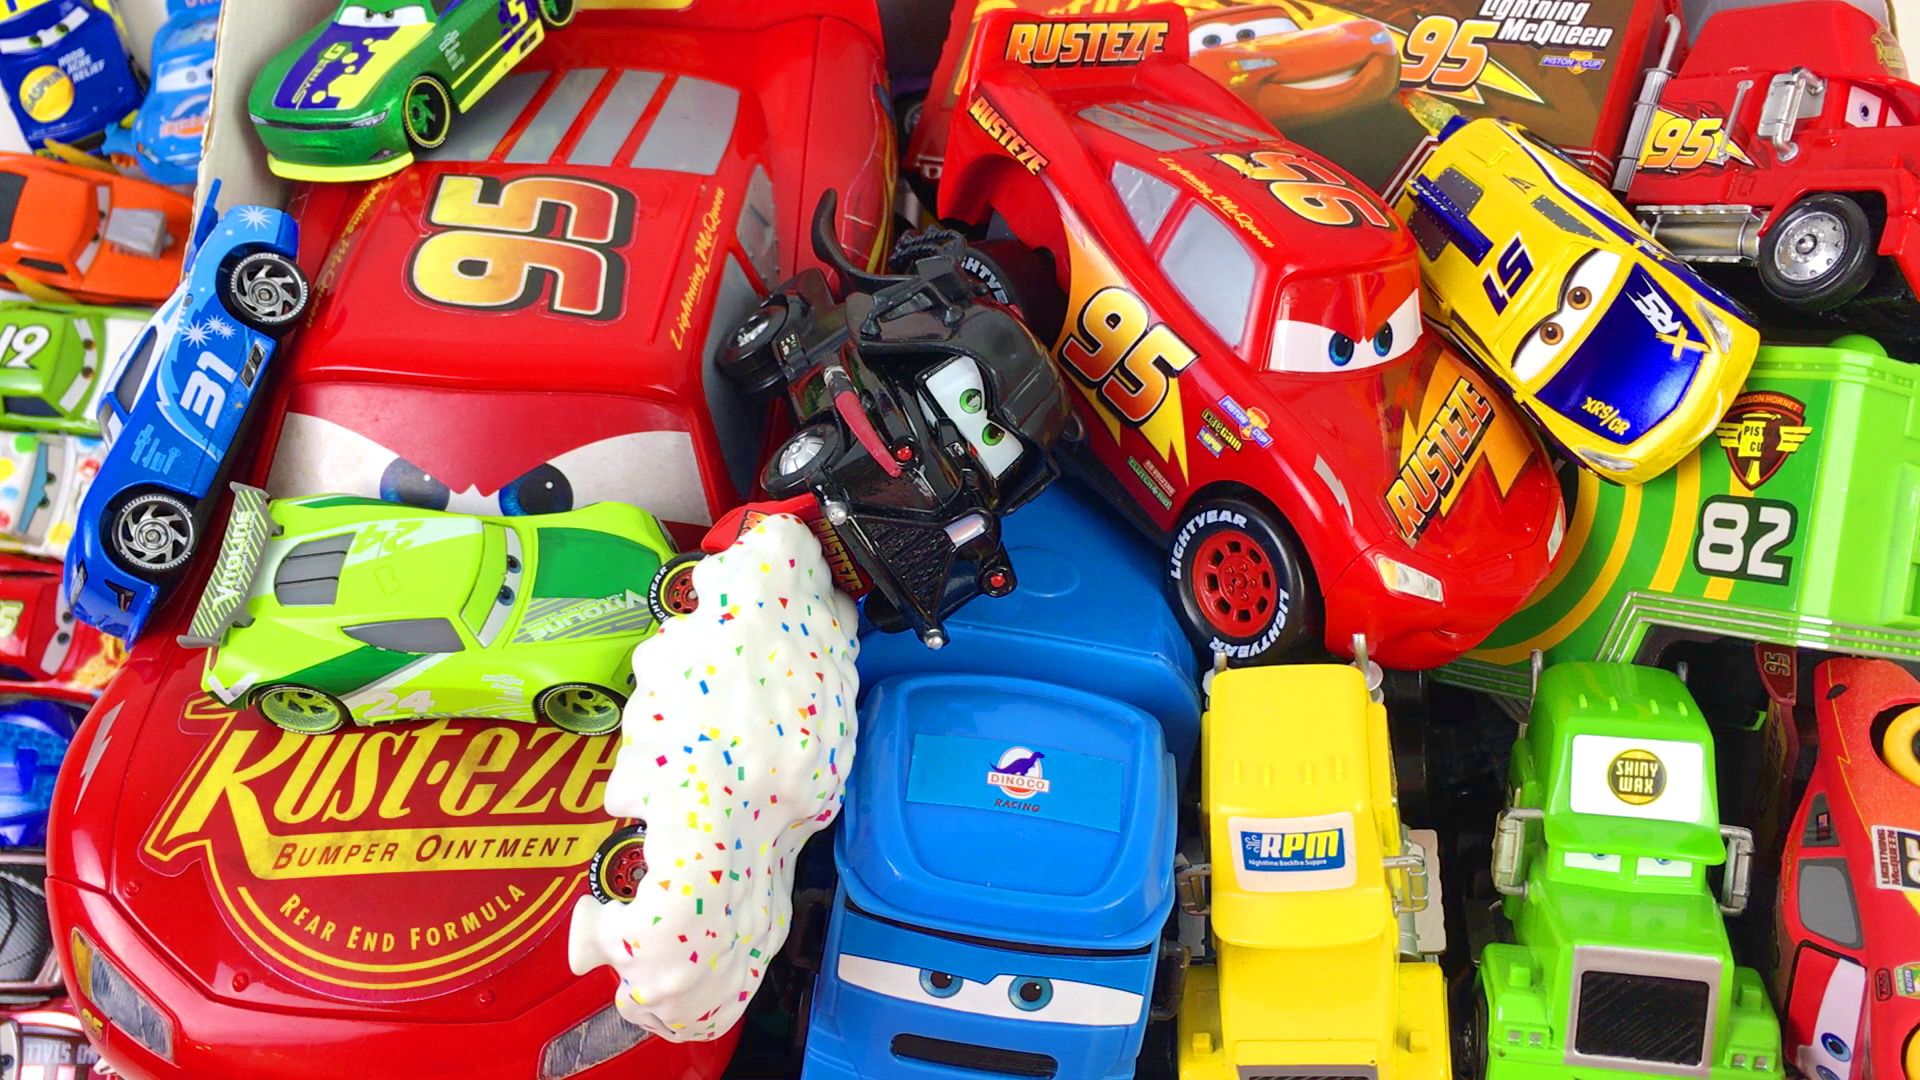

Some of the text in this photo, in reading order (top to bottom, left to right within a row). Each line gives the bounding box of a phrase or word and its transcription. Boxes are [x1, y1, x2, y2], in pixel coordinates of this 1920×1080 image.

[1004, 22, 1169, 68] RUSTEZE
[1399, 15, 1501, 87] 95
[1497, 18, 1614, 47] McQueen
[1543, 56, 1602, 69] PISTON CUP
[968, 96, 1050, 176] RUSTEZE
[1643, 117, 1723, 170] 95
[1245, 150, 1391, 229] 95
[411, 174, 622, 318] 95
[1482, 231, 1534, 317] 51
[0, 325, 50, 368] 19
[1058, 287, 1200, 425] 95
[179, 350, 237, 430] 31
[1580, 396, 1631, 437] XRS/CR
[1385, 376, 1494, 539] RUSTEZE
[1744, 425, 1764, 437] PIS
[1171, 509, 1248, 580] LIGHTYEAR
[1698, 502, 1792, 579] 82
[648, 566, 668, 621] IGHTYEAR
[1209, 588, 1290, 659] LIGHTYEAR
[363, 690, 436, 717] 24
[990, 773, 1045, 790] DINOCO
[1615, 760, 1659, 777] SHINY
[1618, 777, 1654, 794] WAX
[994, 798, 1041, 813] RACING
[272, 833, 581, 871] BUMPER OINTMENT
[1260, 830, 1339, 860] RPM
[1877, 829, 1891, 885] LIGHTNING
[279, 884, 526, 953] REAR END FORMULA
